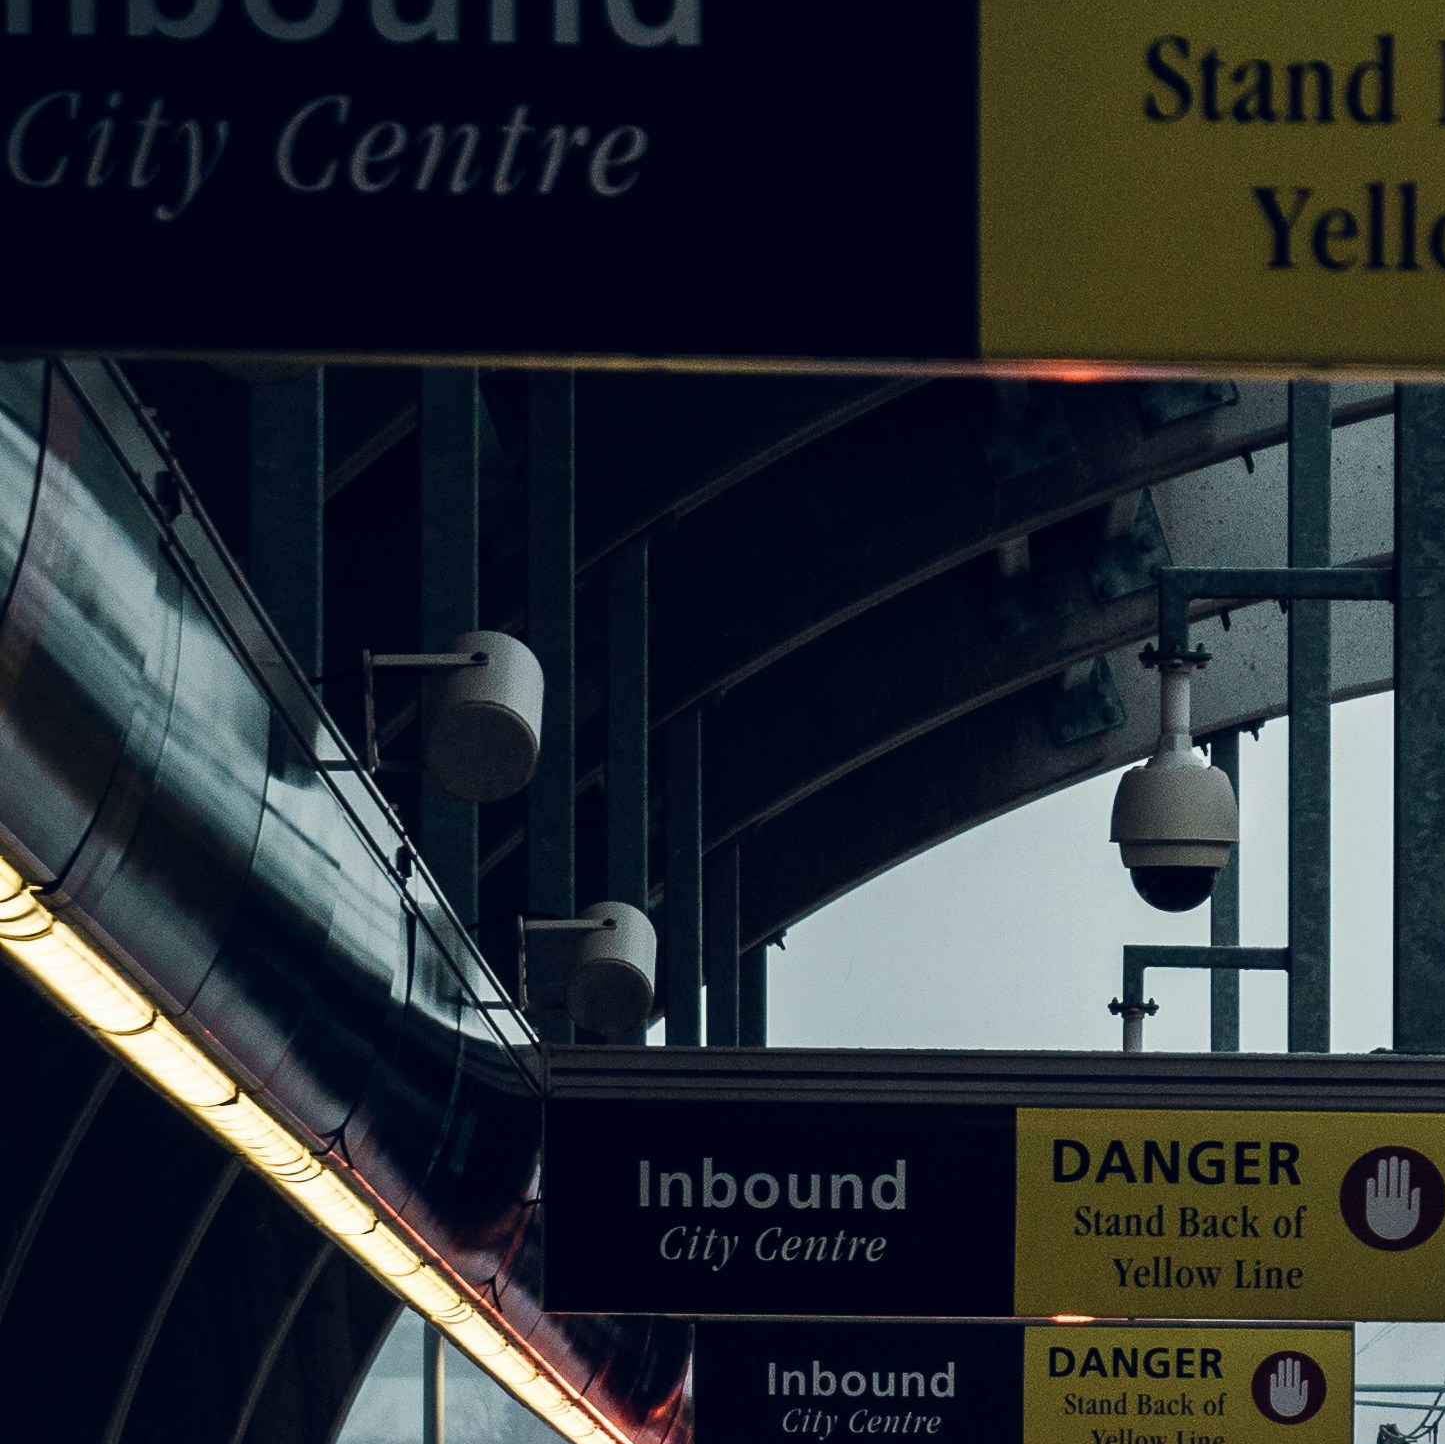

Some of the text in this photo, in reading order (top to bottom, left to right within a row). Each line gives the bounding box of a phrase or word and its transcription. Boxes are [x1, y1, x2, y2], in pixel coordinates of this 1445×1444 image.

[1142, 32, 1399, 127] Stand
[5, 90, 649, 224] City Centre
[1052, 1139, 1301, 1186] DANGER
[639, 1157, 907, 1211] Inbound
[1073, 1204, 1308, 1239] Stand Back of
[659, 1225, 888, 1273] City Centre
[1113, 1256, 1304, 1290] Yellow Line
[768, 1360, 955, 1398] Inbound
[1048, 1346, 1223, 1379] DANGER
[1064, 1392, 1228, 1417] Stand Back of
[781, 1408, 942, 1441] City Centre
